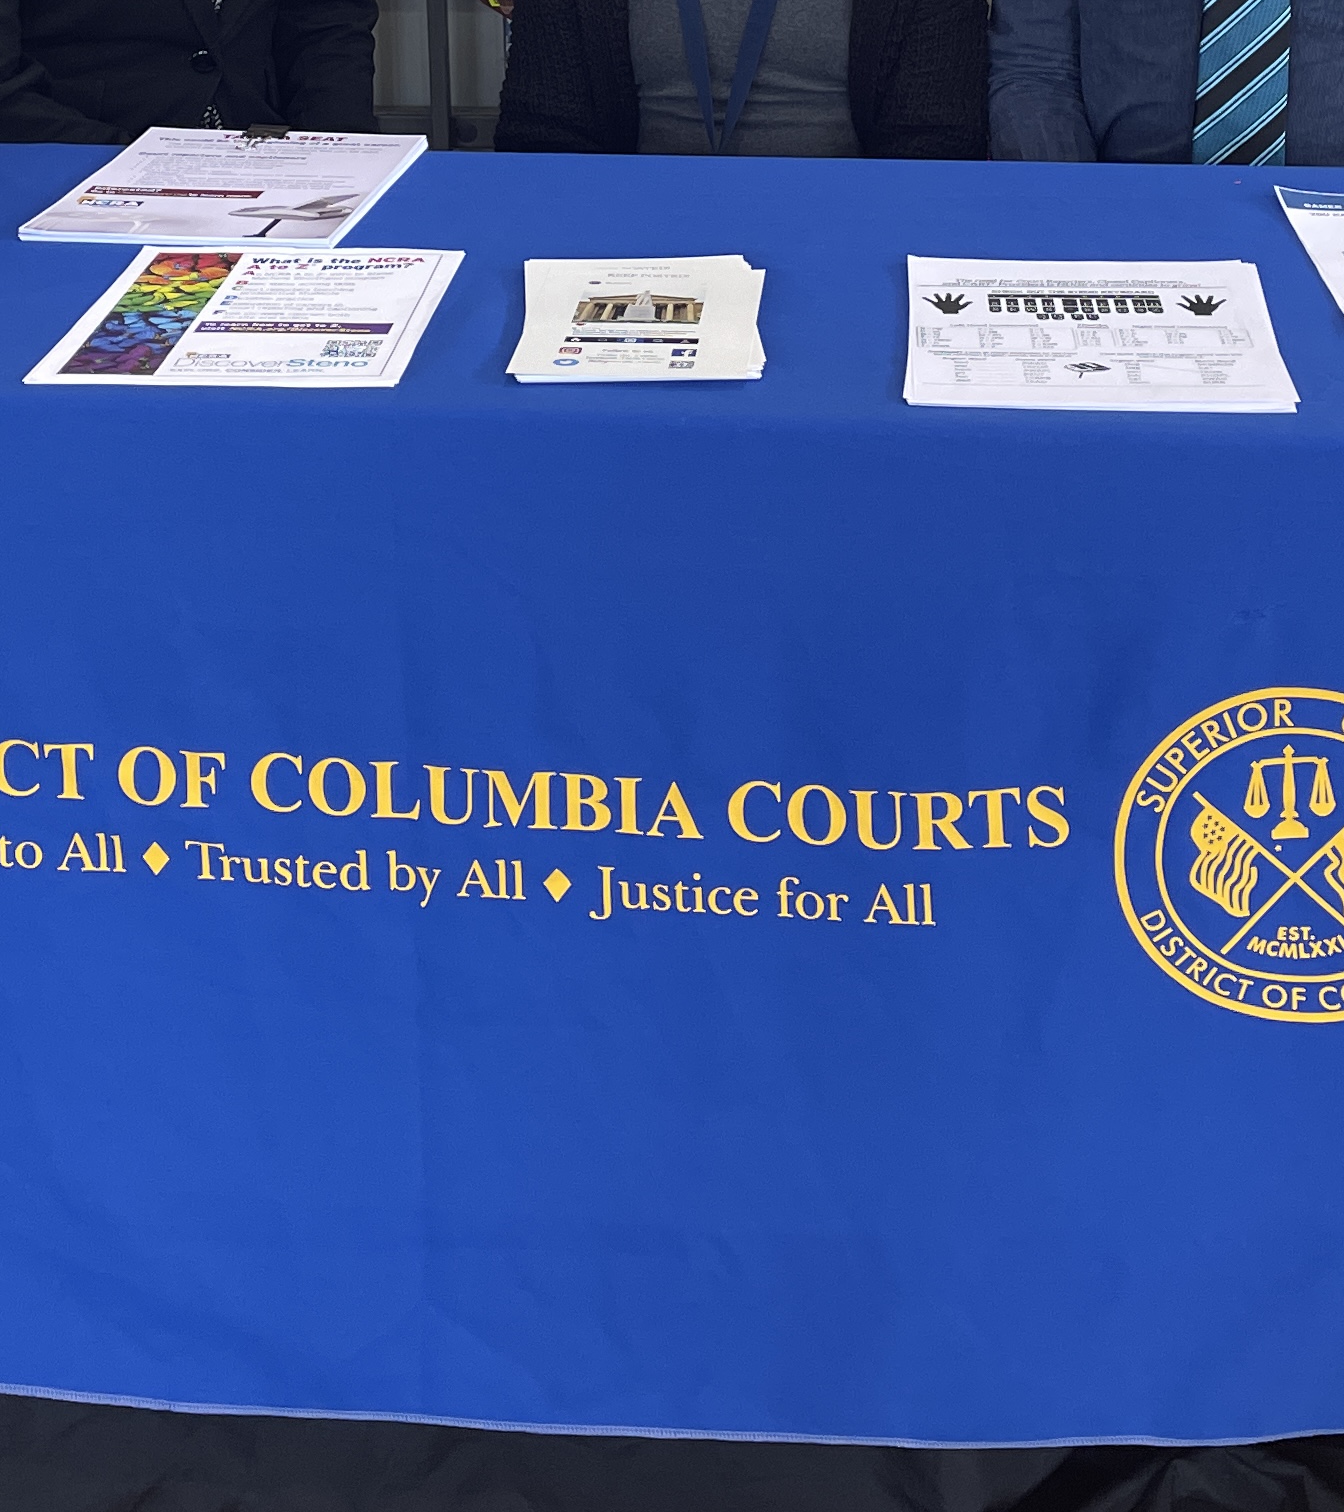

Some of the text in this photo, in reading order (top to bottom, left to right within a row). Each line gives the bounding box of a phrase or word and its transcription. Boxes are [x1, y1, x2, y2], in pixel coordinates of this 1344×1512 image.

[118, 745, 226, 808] OF
[250, 751, 705, 840] COLUMBIA
[727, 780, 1071, 851] COURTS
[1136, 698, 1295, 814] SUPERIOR
[56, 831, 127, 873] All
[184, 839, 372, 891] Trusted
[387, 847, 442, 909] by
[456, 858, 527, 901] All
[589, 864, 760, 921] Justice
[776, 876, 850, 922] for
[863, 883, 937, 927] All
[1139, 909, 1254, 1001] DISTRICT
[1261, 984, 1307, 1011] OF
[1277, 926, 1316, 942] EST.
